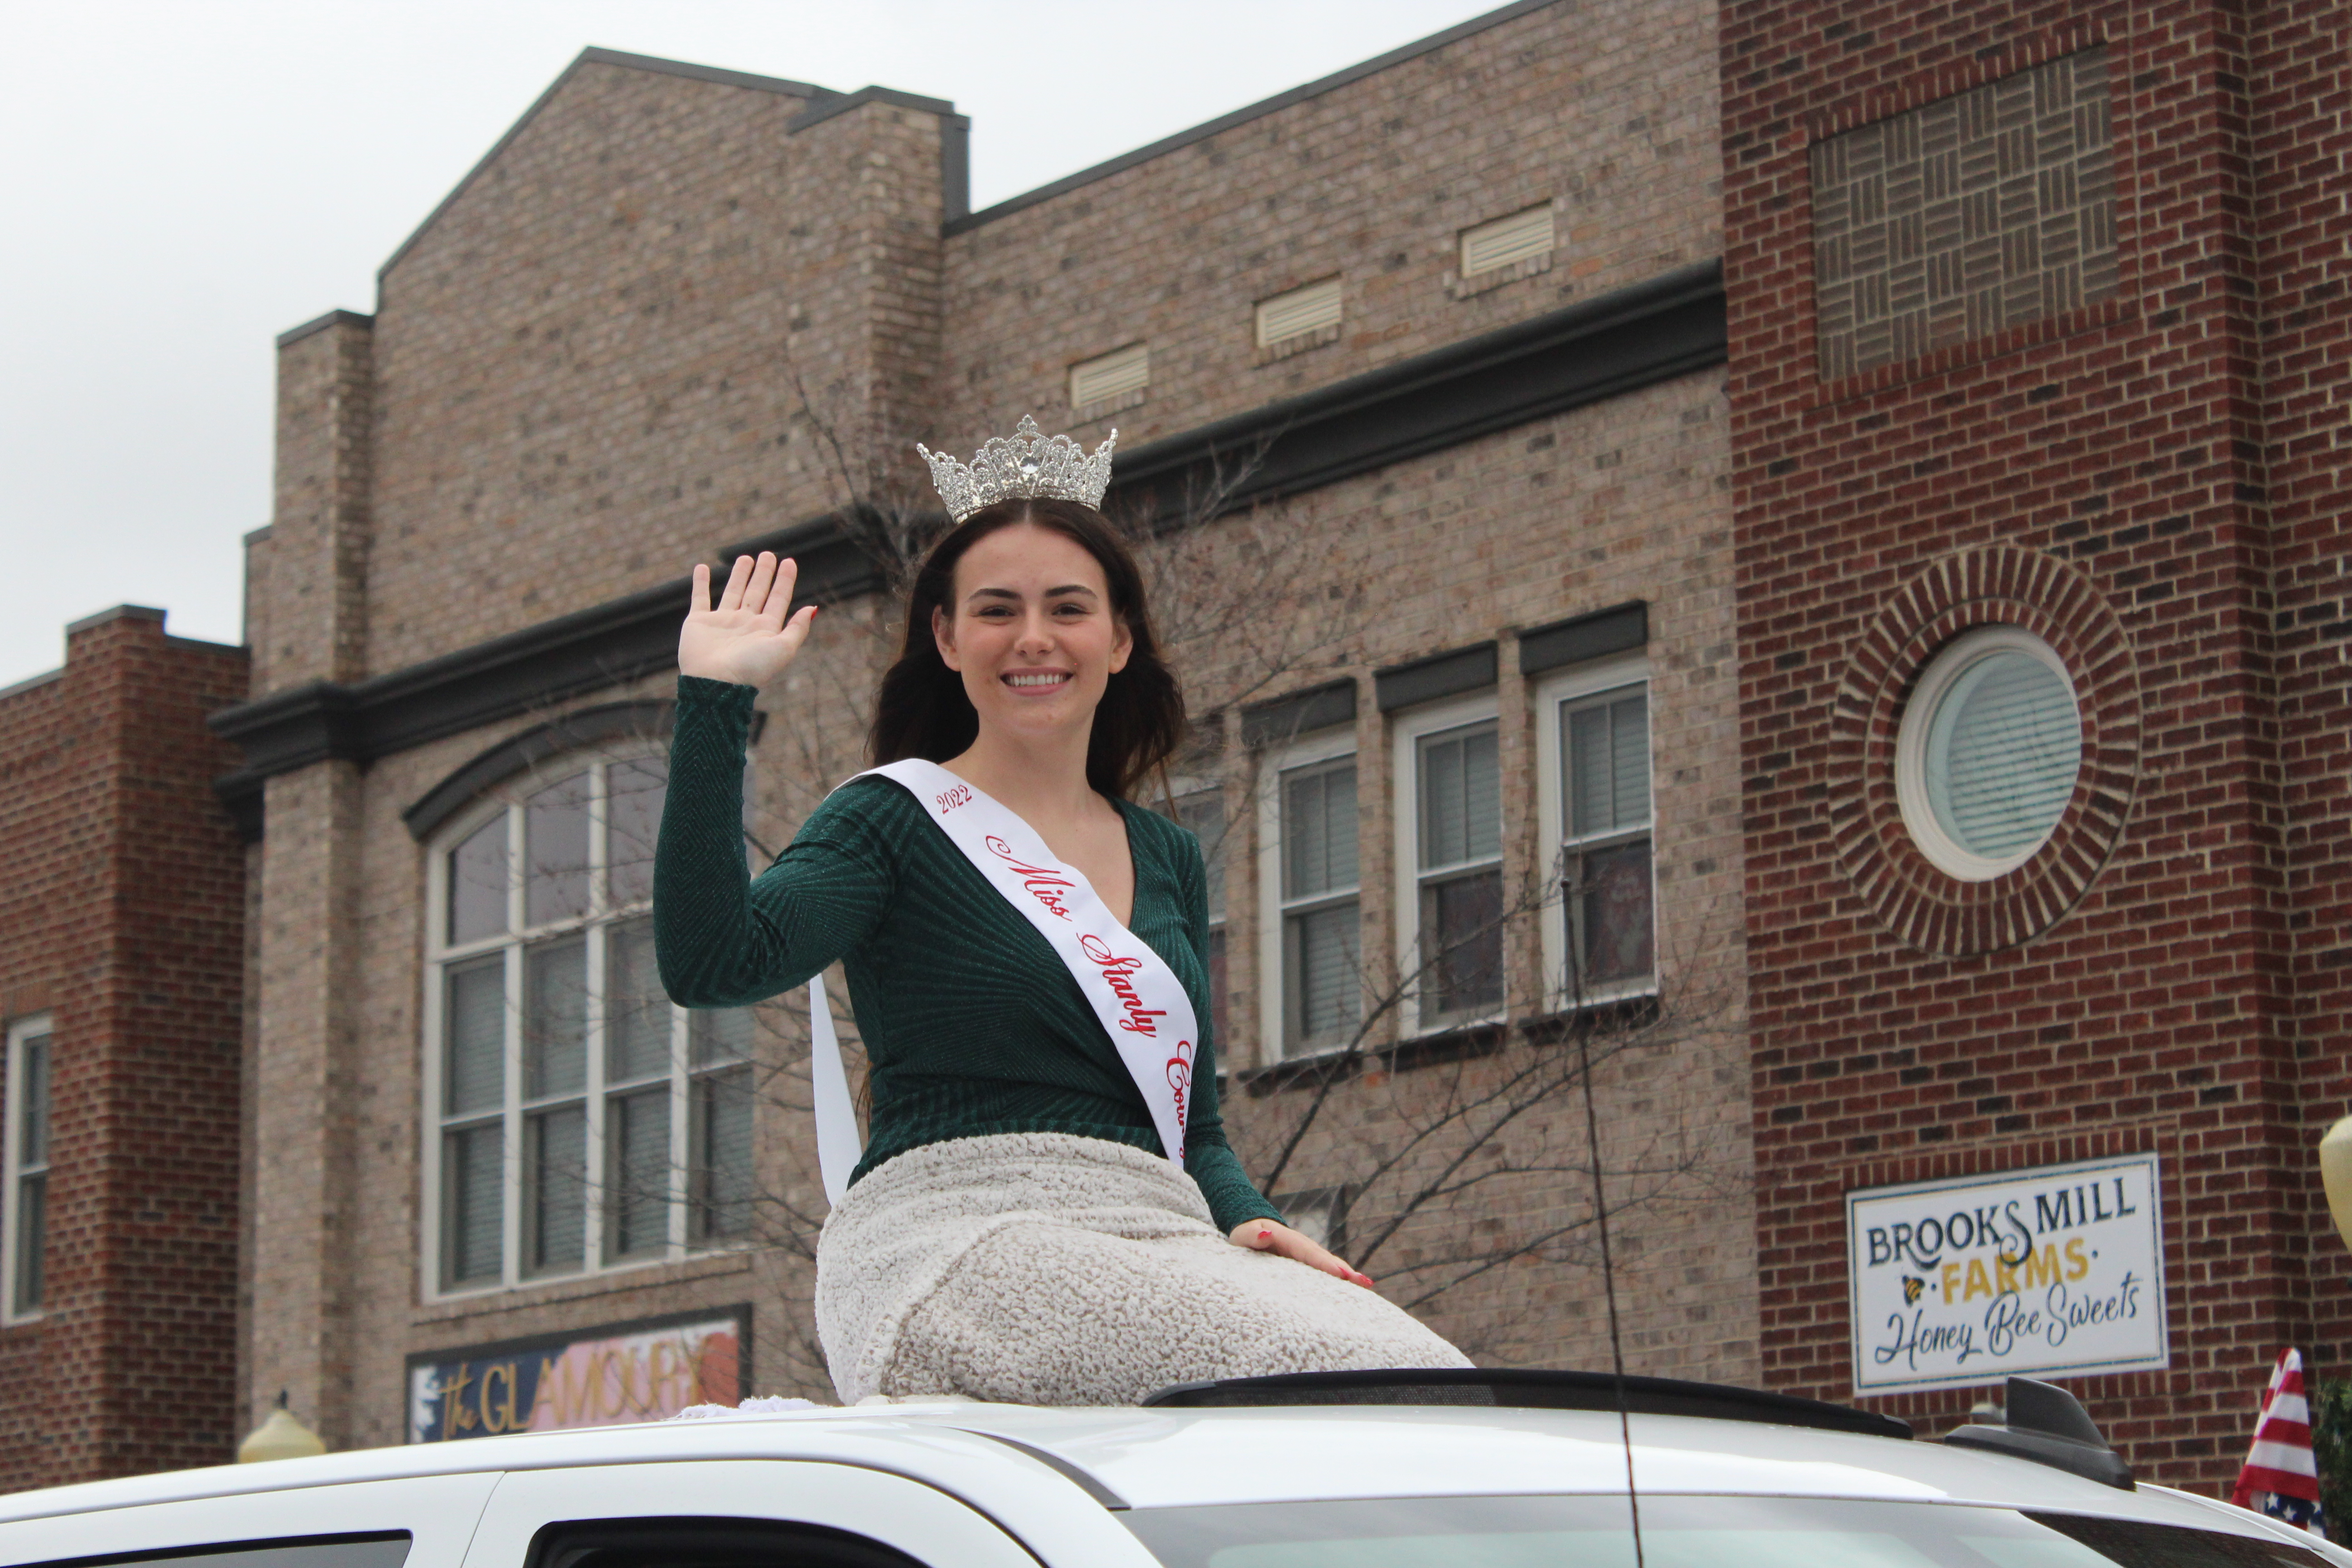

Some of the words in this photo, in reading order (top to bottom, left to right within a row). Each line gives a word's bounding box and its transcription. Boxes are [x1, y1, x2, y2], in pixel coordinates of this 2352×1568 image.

[936, 784, 972, 814] 2022
[985, 835, 1076, 922] Miss
[1076, 932, 1167, 1038] Stanly
[1867, 1200, 2033, 1270] BROOKS
[2035, 1177, 2136, 1234] MILL
[1941, 1236, 2089, 1306] FARMS
[1874, 1308, 1984, 1372] Honey
[1984, 1289, 2042, 1356] Bee
[2046, 1271, 2144, 1347] Sweets
